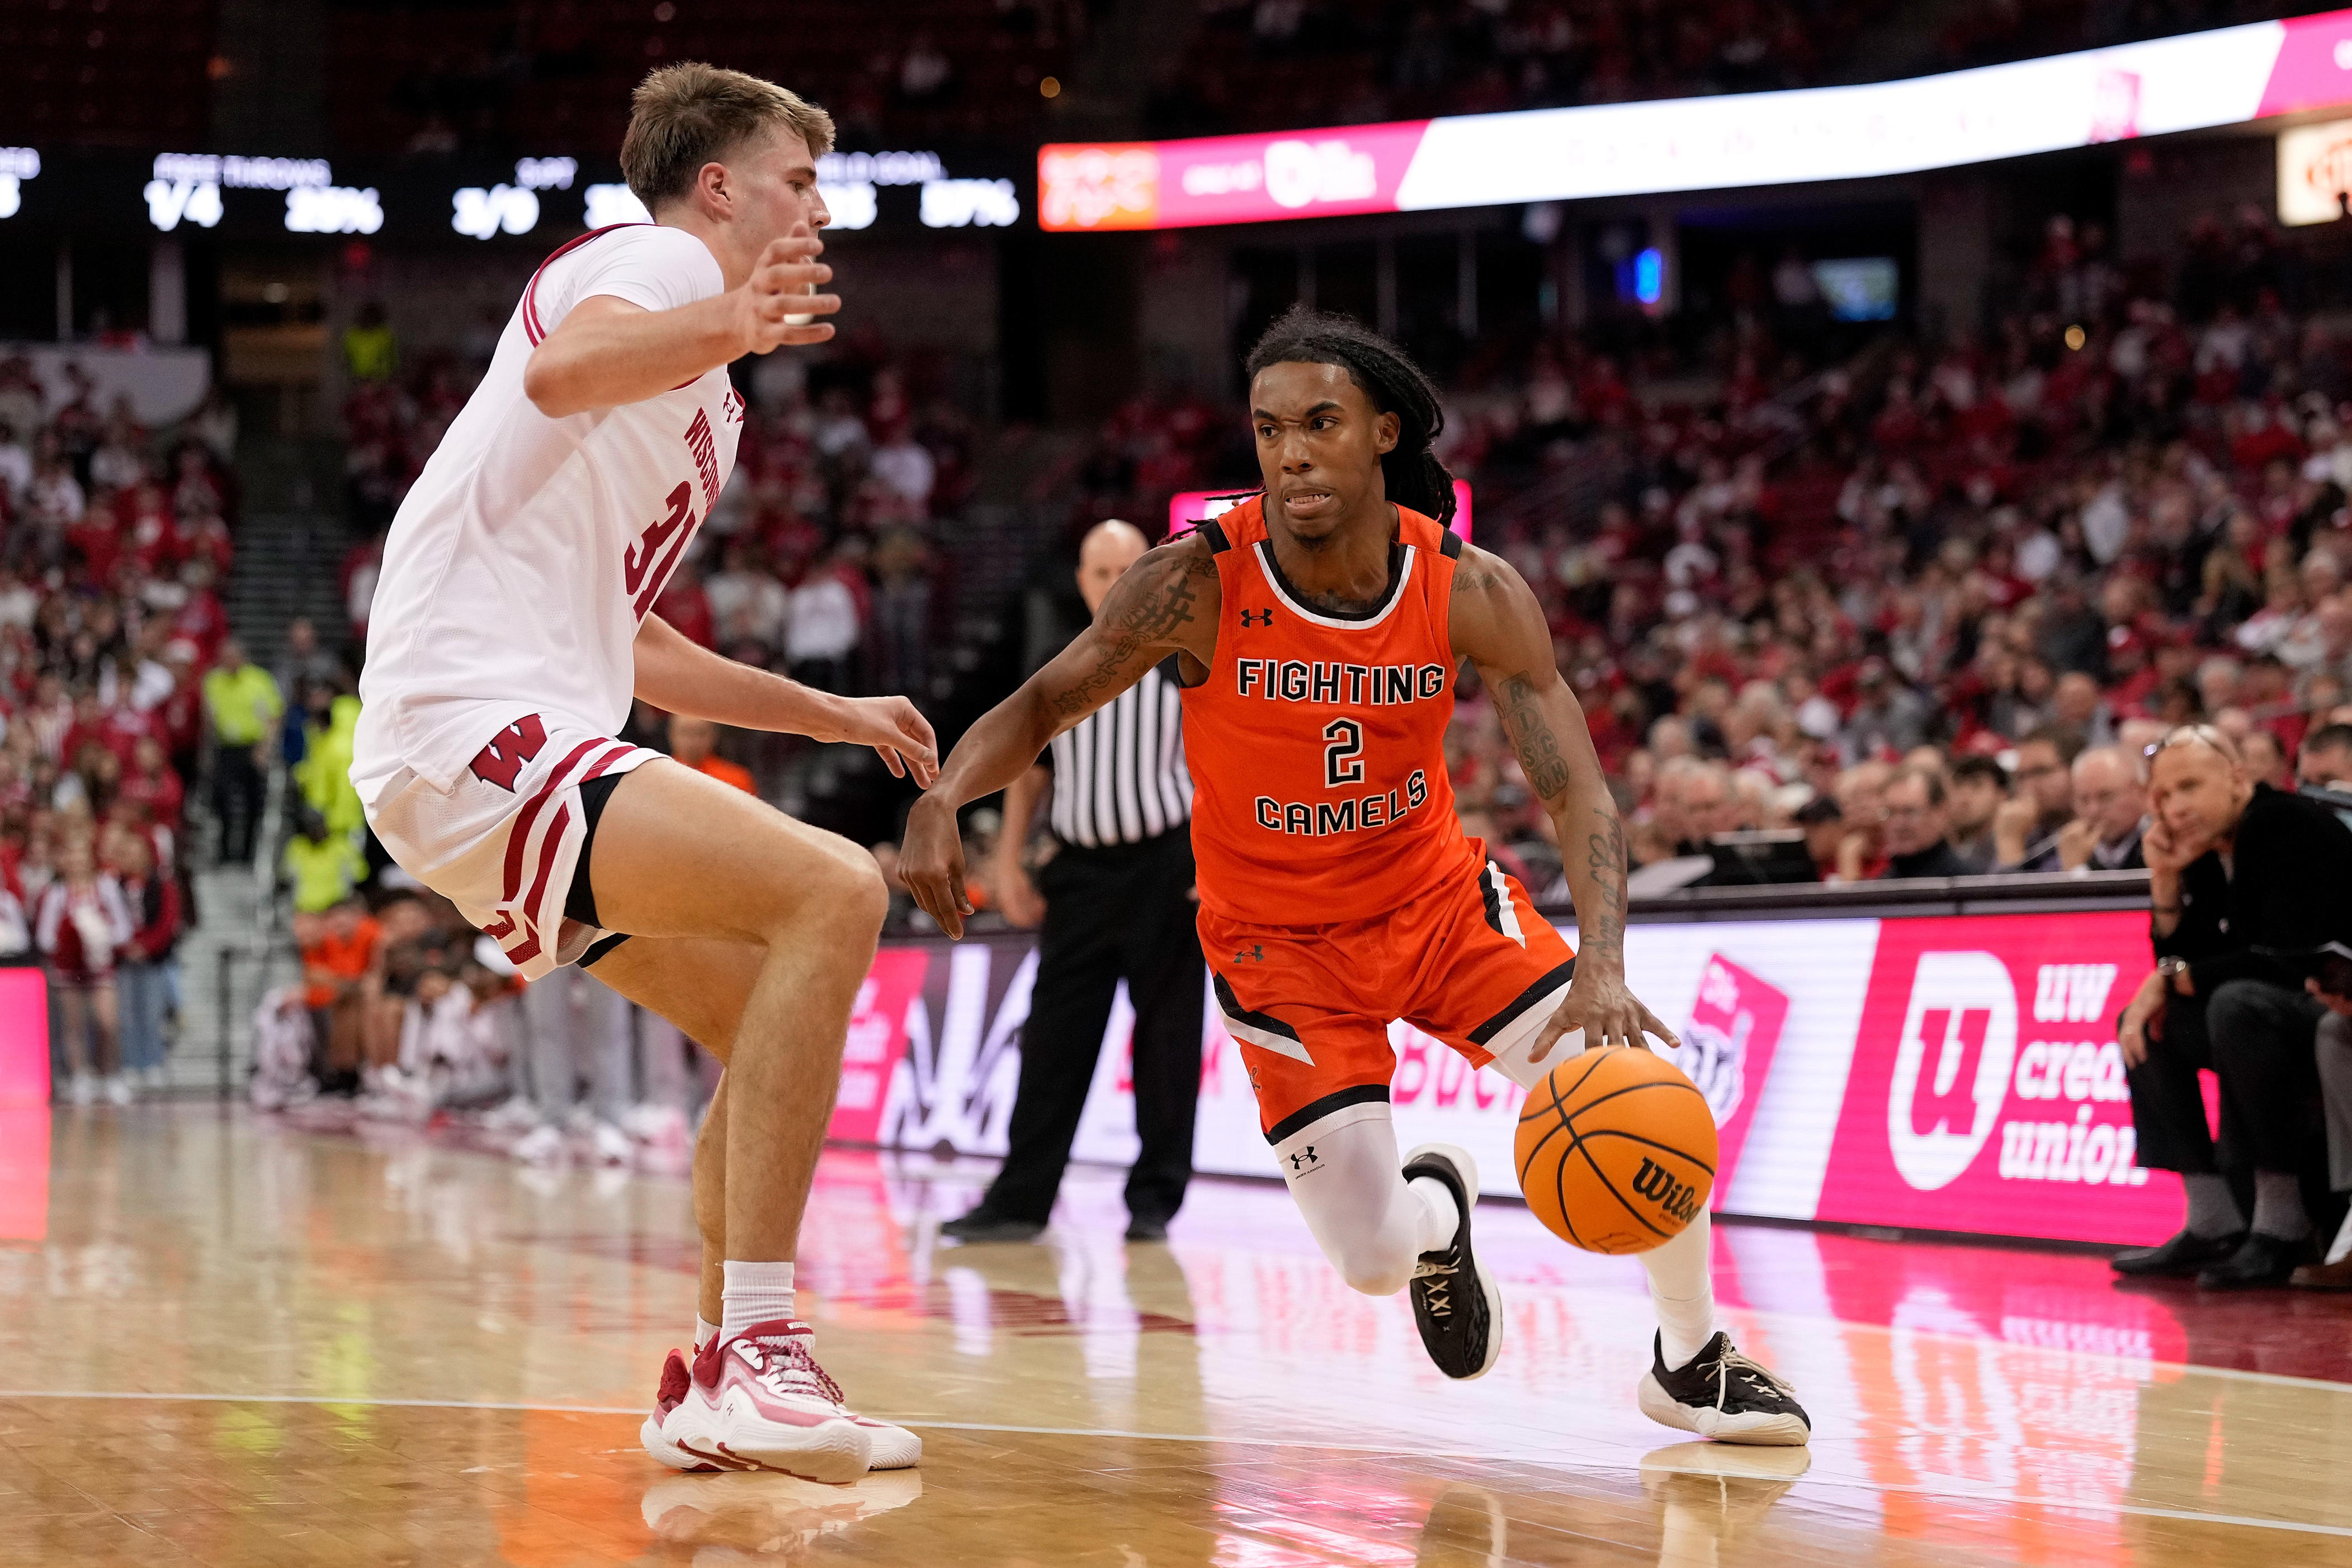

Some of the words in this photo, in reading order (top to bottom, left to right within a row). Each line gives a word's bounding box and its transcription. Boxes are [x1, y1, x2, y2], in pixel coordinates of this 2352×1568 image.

[624, 480, 696, 624] 31
[1237, 657, 1445, 706] FIGHTING
[469, 713, 547, 794] W
[1322, 717, 1364, 788] 2
[1254, 768, 1428, 837] CAMELS
[2015, 1040, 2132, 1101] cred
[1307, 1164, 1325, 1174] ARMOUR
